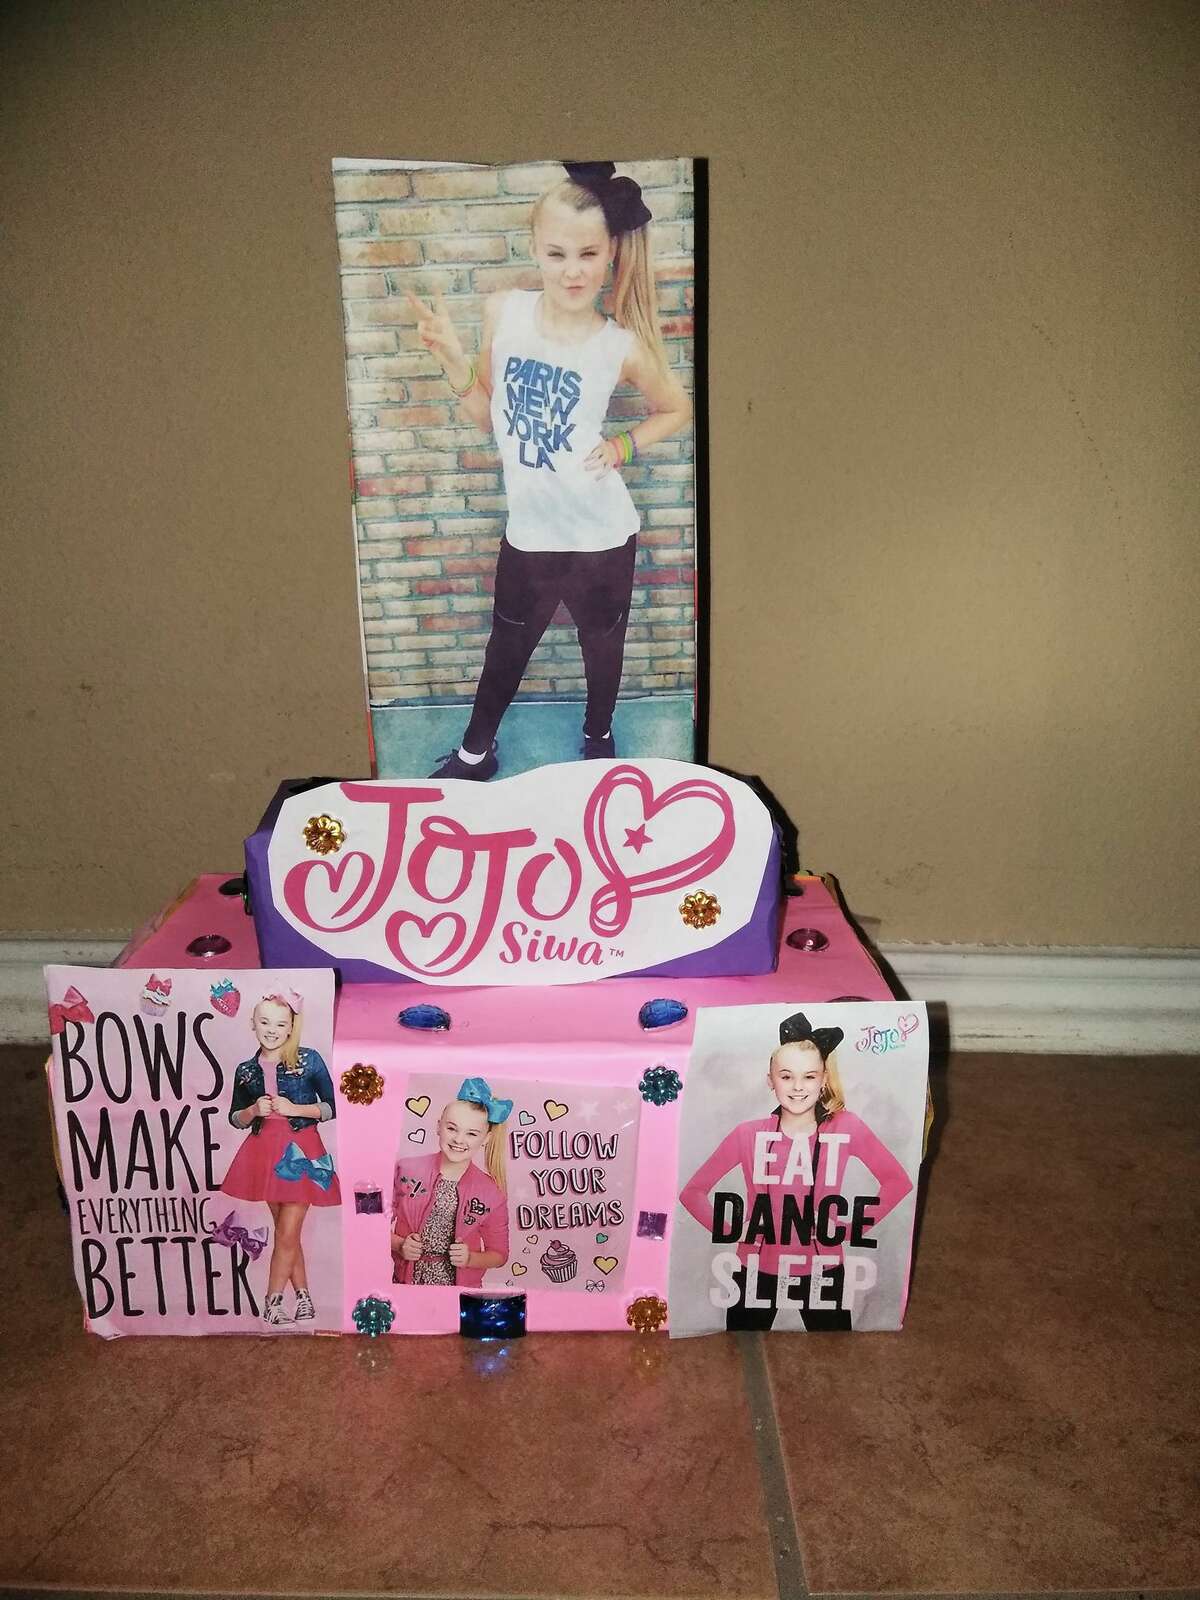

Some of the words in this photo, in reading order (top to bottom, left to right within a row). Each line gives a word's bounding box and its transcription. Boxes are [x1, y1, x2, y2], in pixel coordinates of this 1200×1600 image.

[503, 356, 583, 400] PARIS
[506, 383, 580, 425] NEW
[503, 403, 576, 453] YORK
[519, 441, 557, 472] LA
[499, 920, 605, 966] Siwa
[59, 1011, 224, 1103] BOWS
[66, 1104, 223, 1194] MAKE
[511, 1130, 619, 1160] FOLLOW
[752, 1131, 850, 1187] EAT
[530, 1167, 607, 1196] YOUR
[78, 1197, 218, 1235] EVERYTHING
[518, 1200, 625, 1230] DREAMS
[711, 1191, 881, 1249] DANCE
[81, 1236, 260, 1320] BETTER
[709, 1251, 878, 1310] SLEEP
